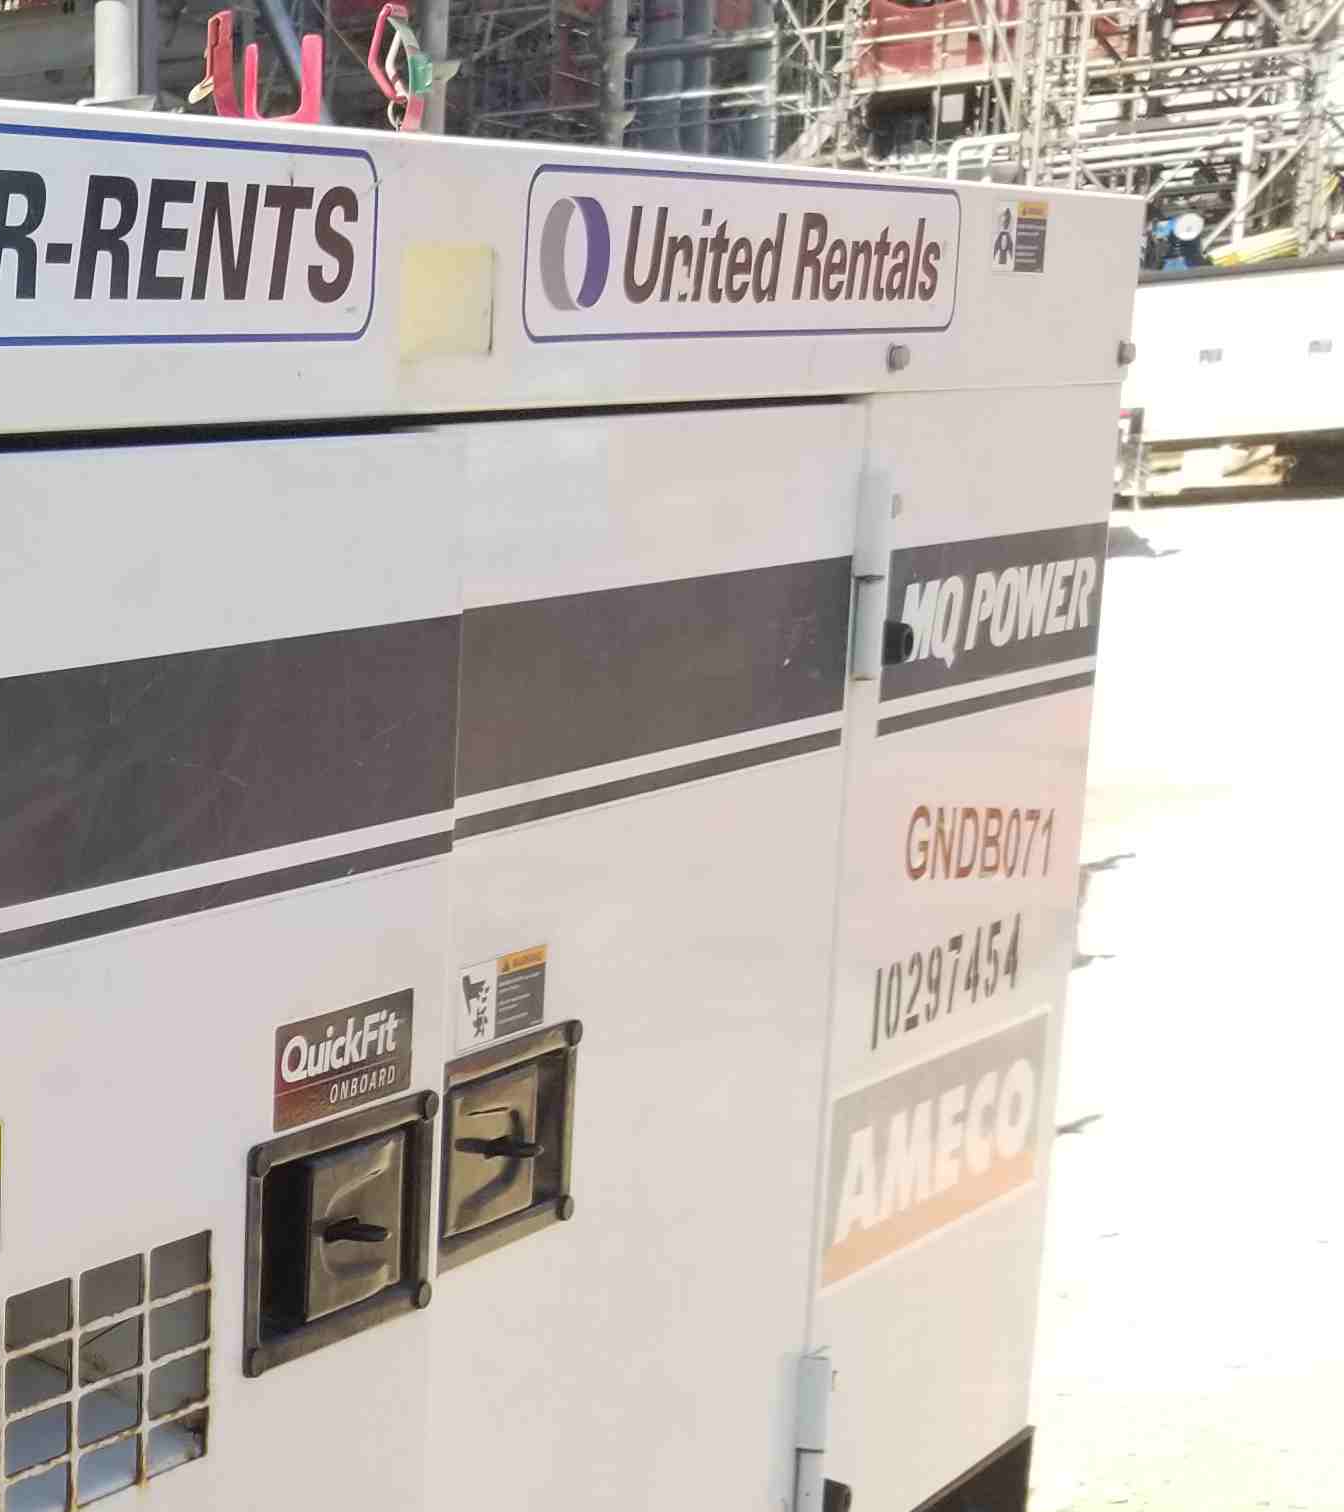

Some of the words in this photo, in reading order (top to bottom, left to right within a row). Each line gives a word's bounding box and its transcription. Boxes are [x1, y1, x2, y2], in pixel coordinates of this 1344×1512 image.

[622, 203, 784, 306] United
[792, 212, 942, 303] Rentals
[900, 575, 964, 669] MQ
[963, 556, 1097, 651] POWER
[905, 804, 1055, 881] GNDB071
[870, 911, 1022, 1052] 10297454
[280, 1009, 399, 1083] QuickFit
[329, 1065, 396, 1104] ONBOARD
[831, 1056, 1036, 1247] AMECO
